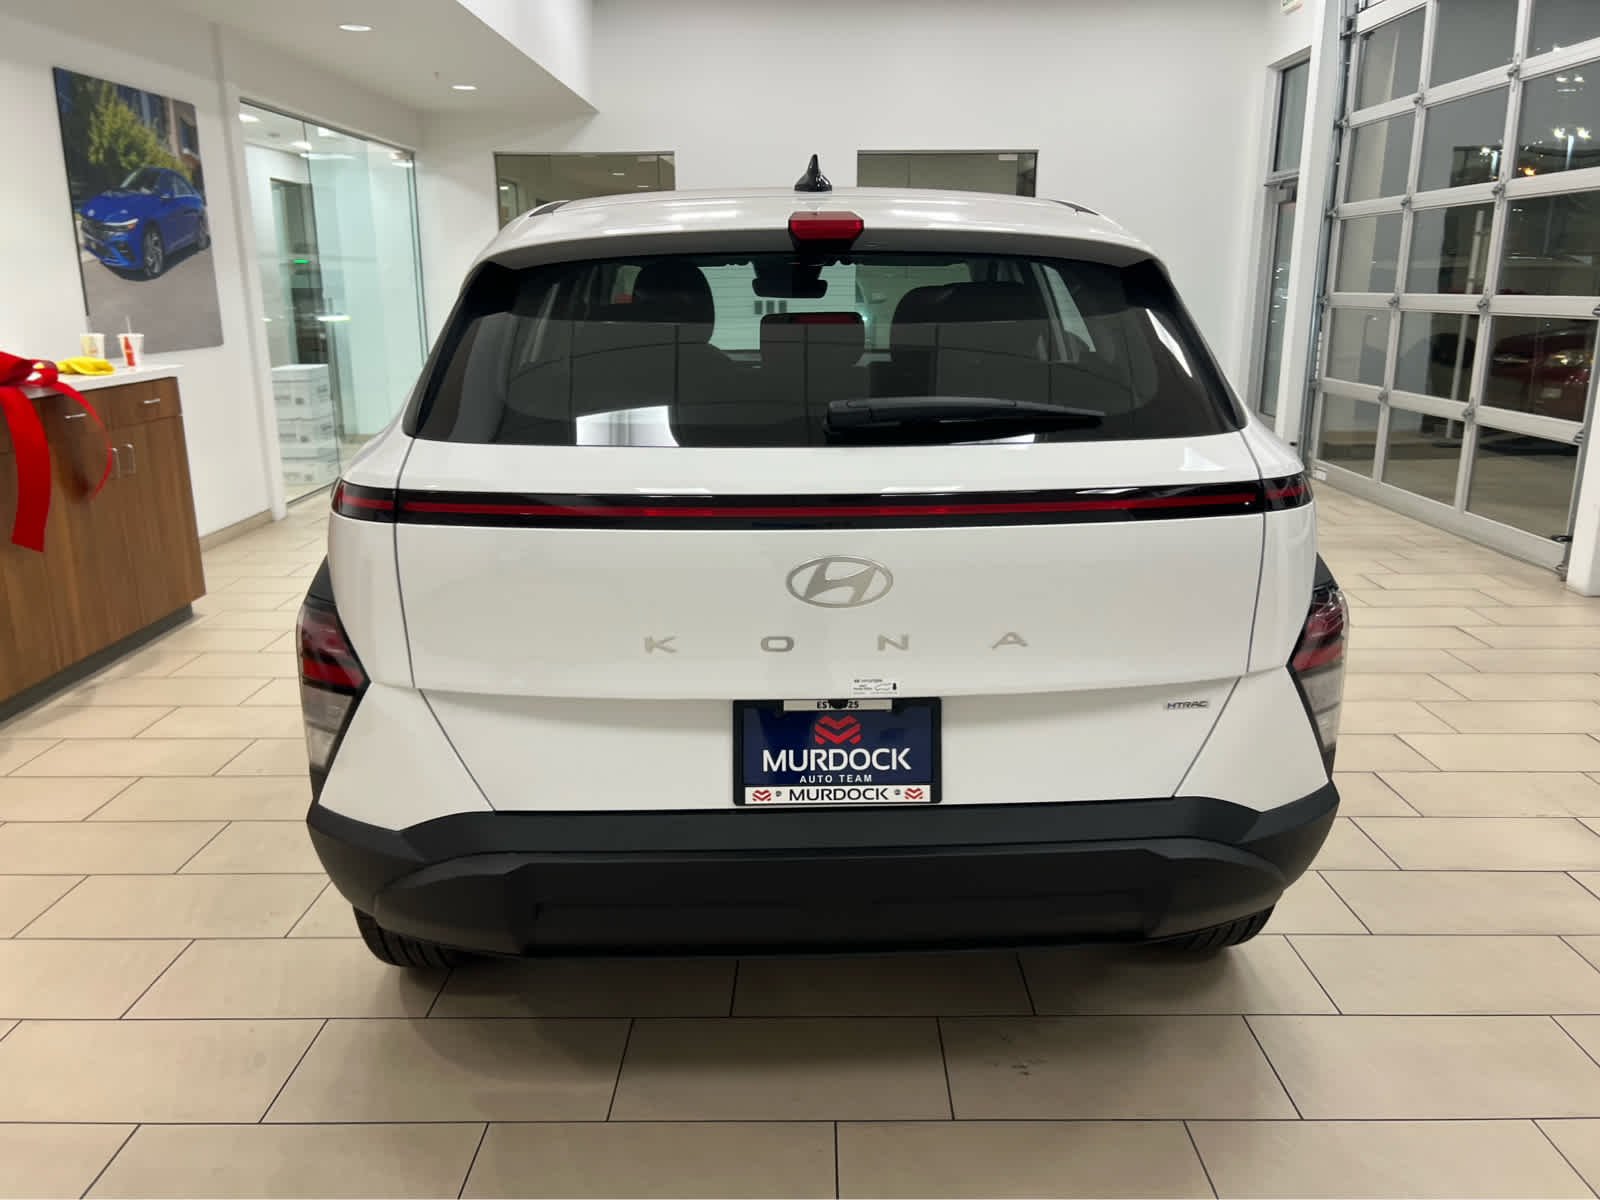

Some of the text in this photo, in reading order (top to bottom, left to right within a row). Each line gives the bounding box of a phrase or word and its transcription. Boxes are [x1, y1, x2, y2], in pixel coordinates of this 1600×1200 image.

[644, 632, 1029, 654] KONA
[1167, 700, 1208, 709] HTRAC
[762, 748, 911, 772] MURDOCK
[800, 774, 873, 783] AUTO TEAM
[789, 788, 888, 801] MURDOCK
